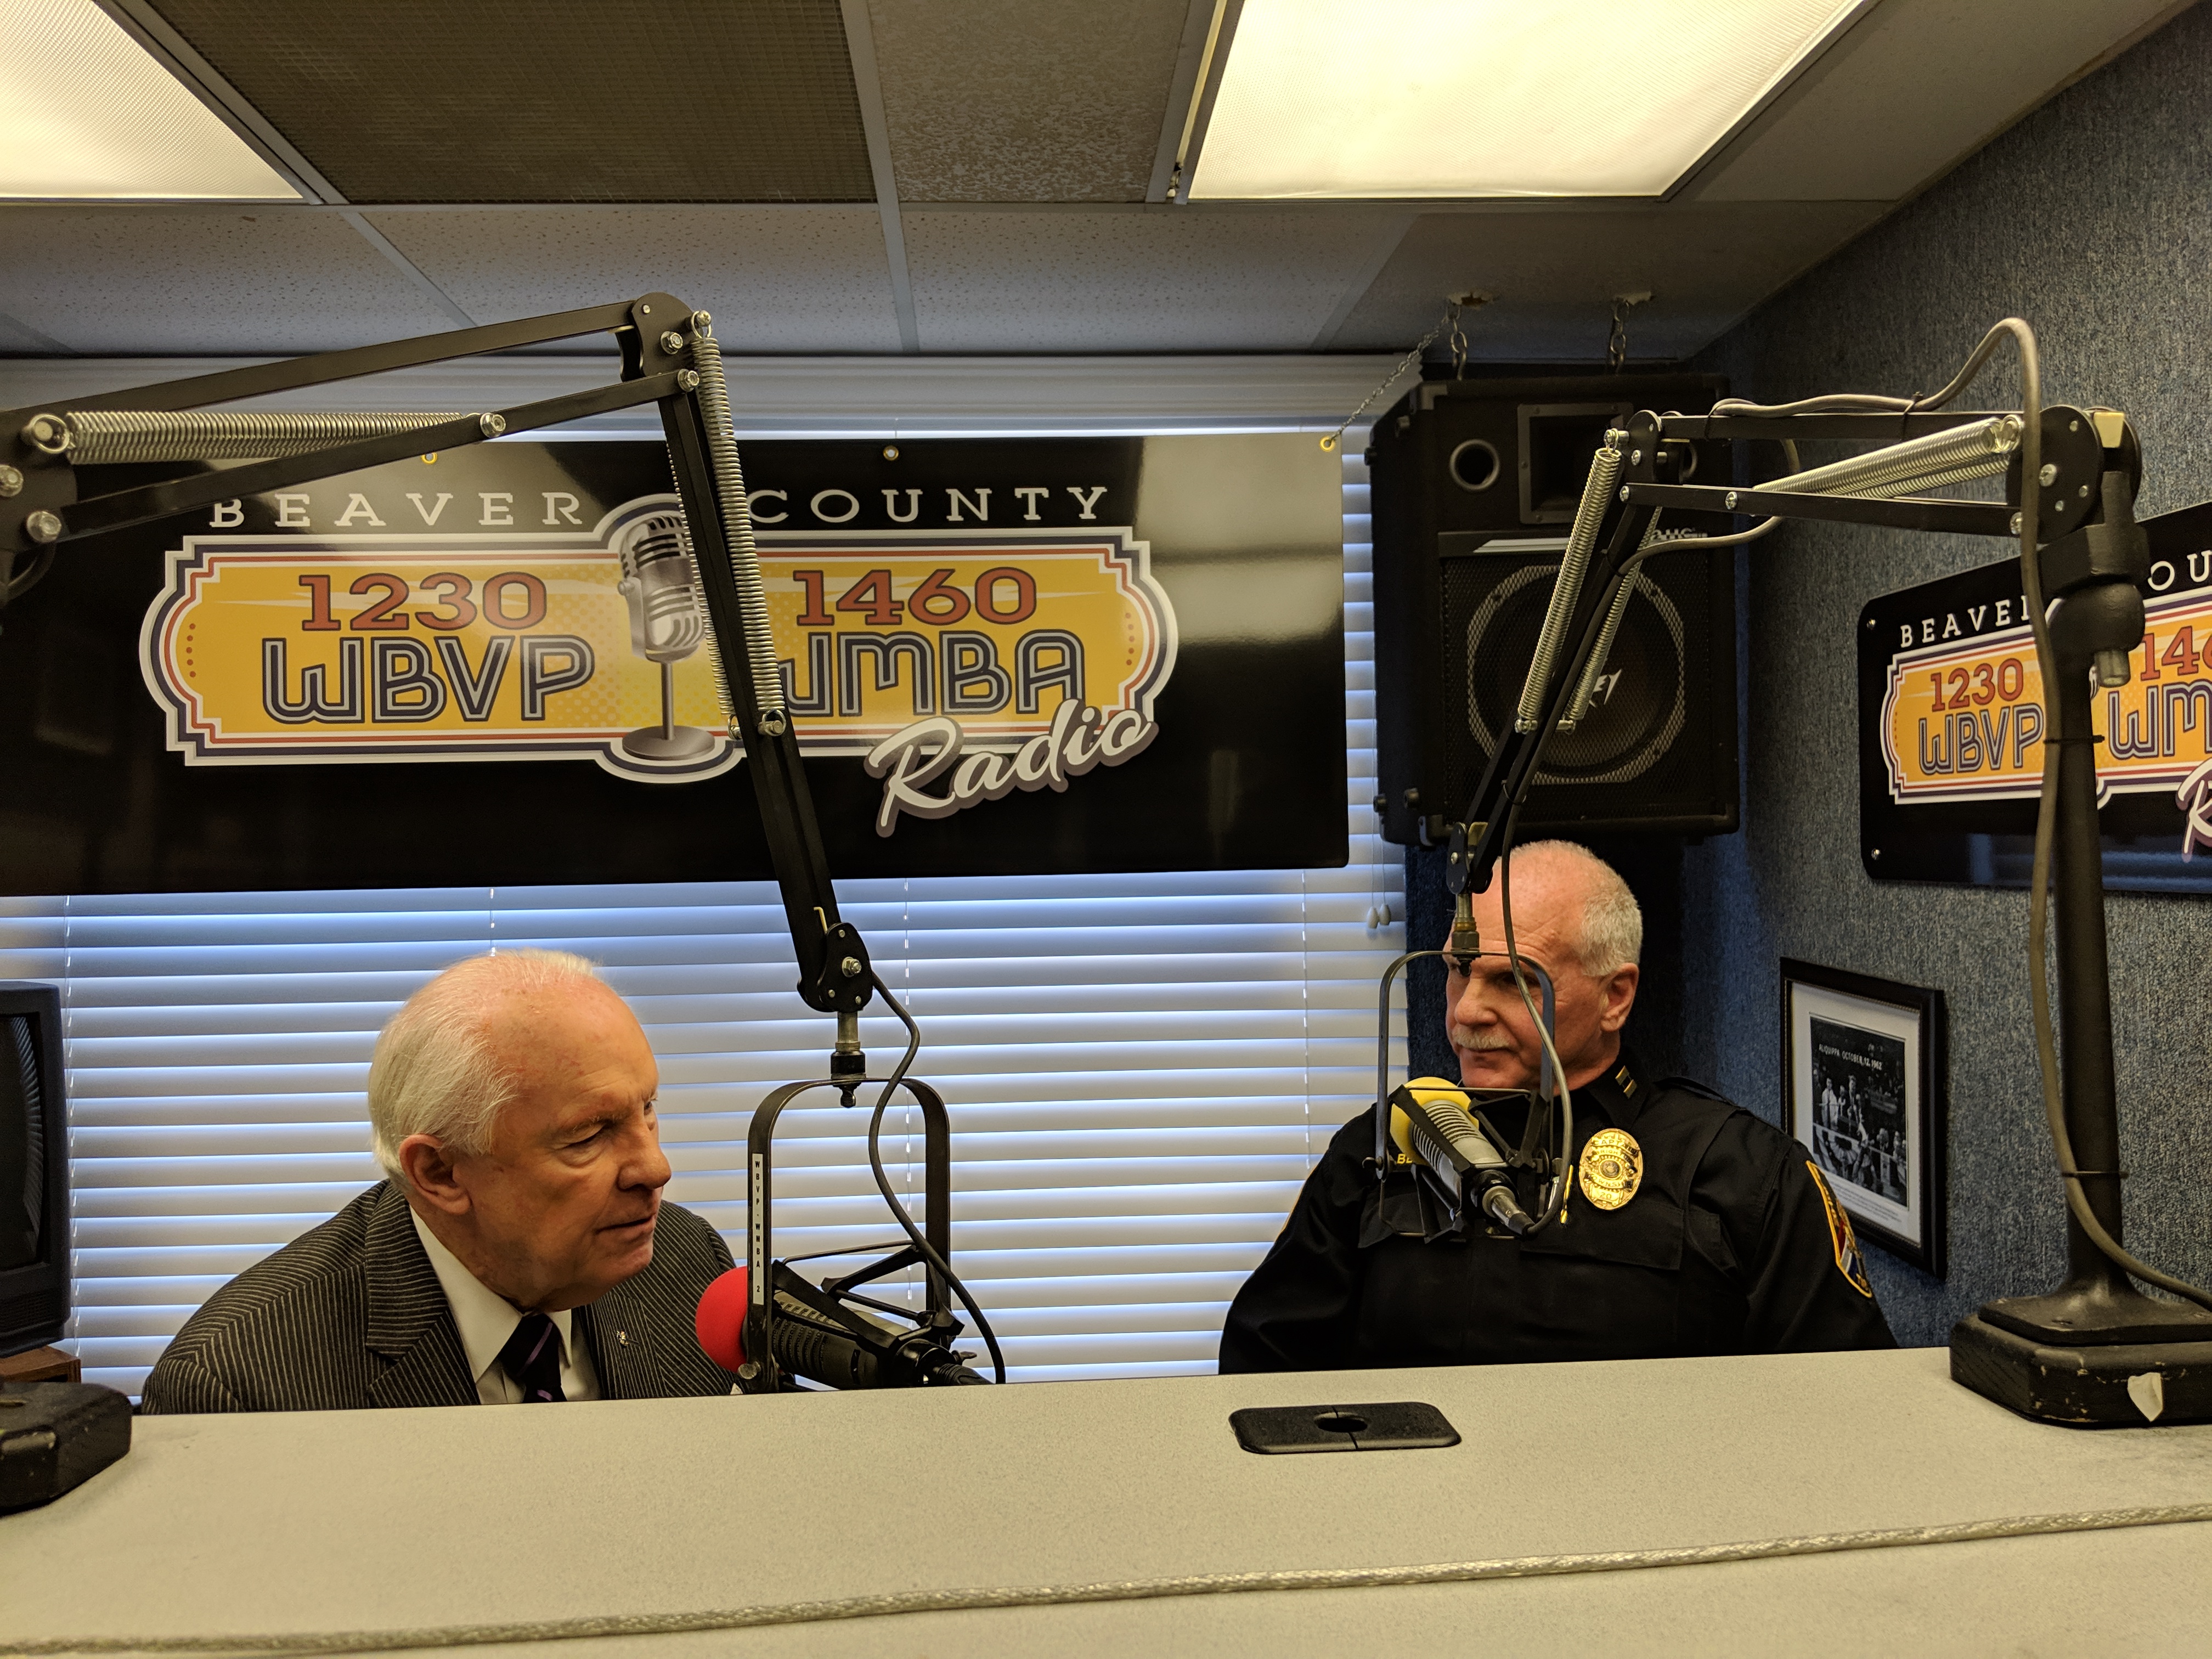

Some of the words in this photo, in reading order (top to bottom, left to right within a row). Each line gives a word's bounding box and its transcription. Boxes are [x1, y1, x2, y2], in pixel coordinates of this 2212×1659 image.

[209, 492, 583, 528] BEAVER
[746, 487, 1107, 524] COUNTY
[793, 567, 1037, 627] 1460
[2148, 550, 2212, 591] OU
[298, 572, 548, 631] 1230
[262, 635, 595, 725] WBVP
[2141, 626, 2212, 681] 14
[1931, 658, 2024, 712] 1230
[866, 698, 1156, 832] Radio
[1918, 703, 2045, 776] WBVP
[1600, 1192, 1612, 1200] 20
